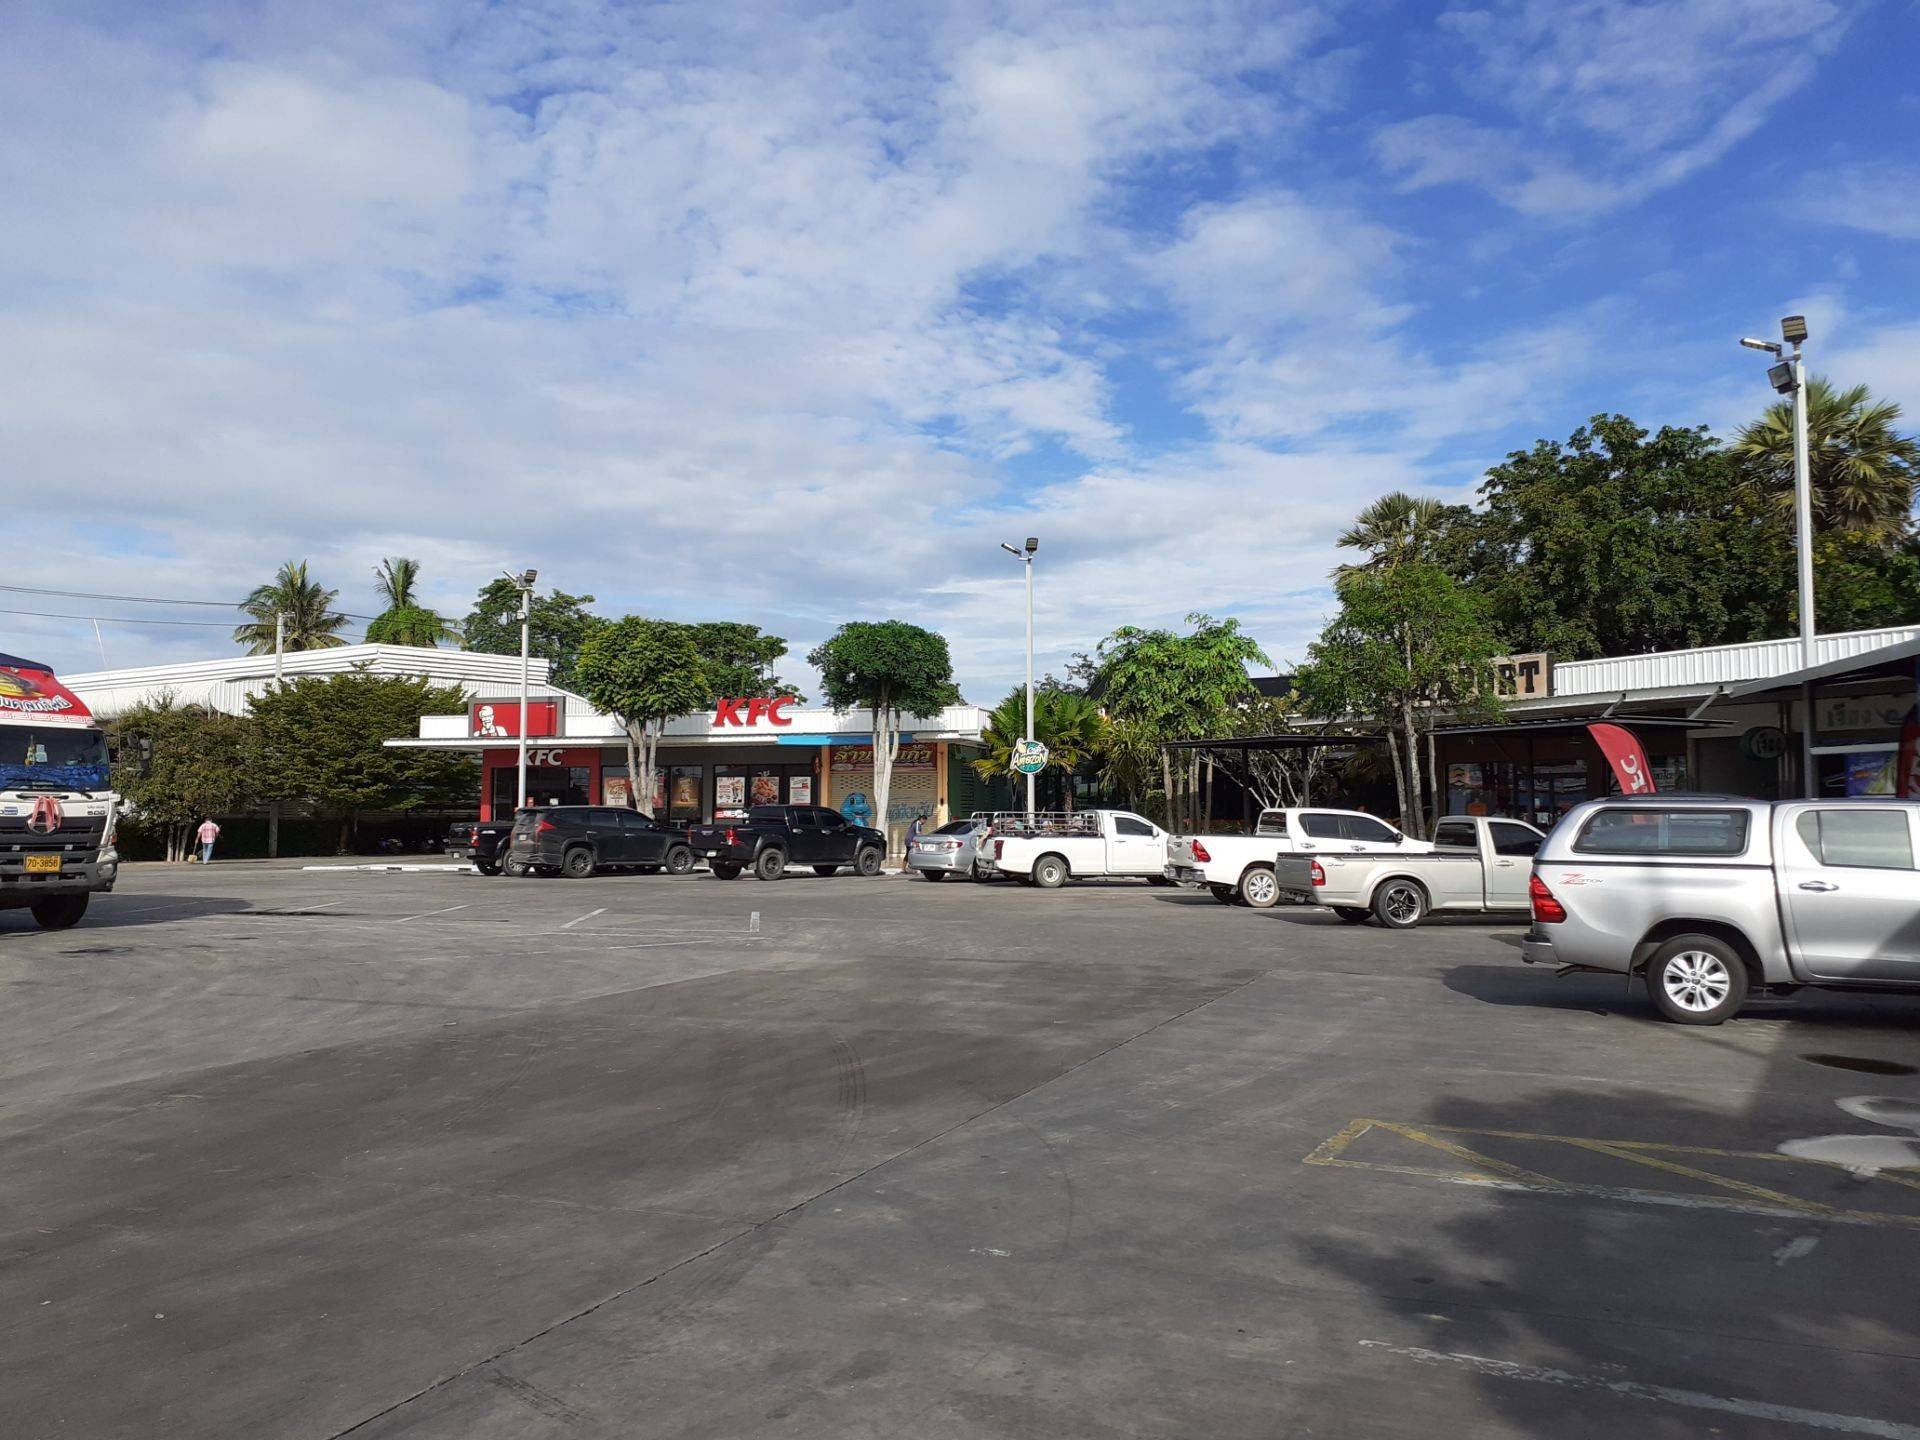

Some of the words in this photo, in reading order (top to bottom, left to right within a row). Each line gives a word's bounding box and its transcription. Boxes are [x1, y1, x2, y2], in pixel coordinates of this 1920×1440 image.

[712, 696, 796, 728] KFC
[514, 748, 564, 766] KFC
[1620, 753, 1649, 793] FC
